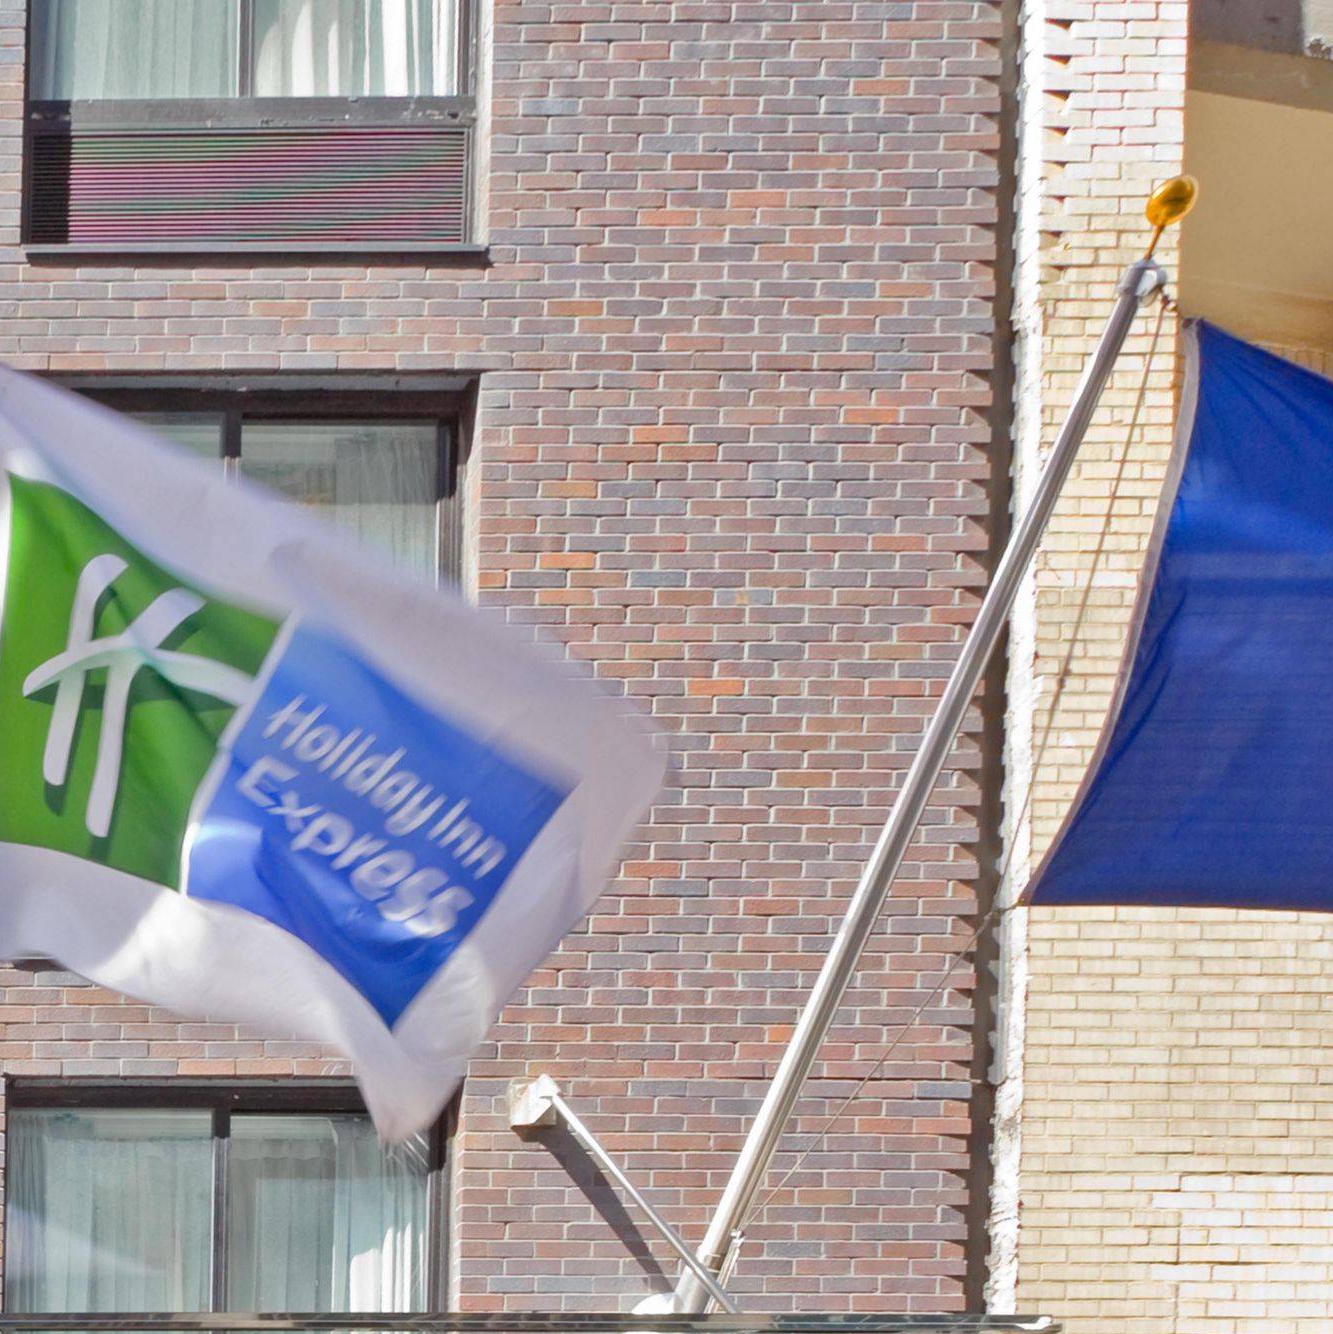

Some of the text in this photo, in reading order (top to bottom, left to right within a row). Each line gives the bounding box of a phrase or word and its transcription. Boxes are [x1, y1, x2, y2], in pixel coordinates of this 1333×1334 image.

[235, 754, 474, 938] Express
[263, 691, 507, 879] Holiday Inn
